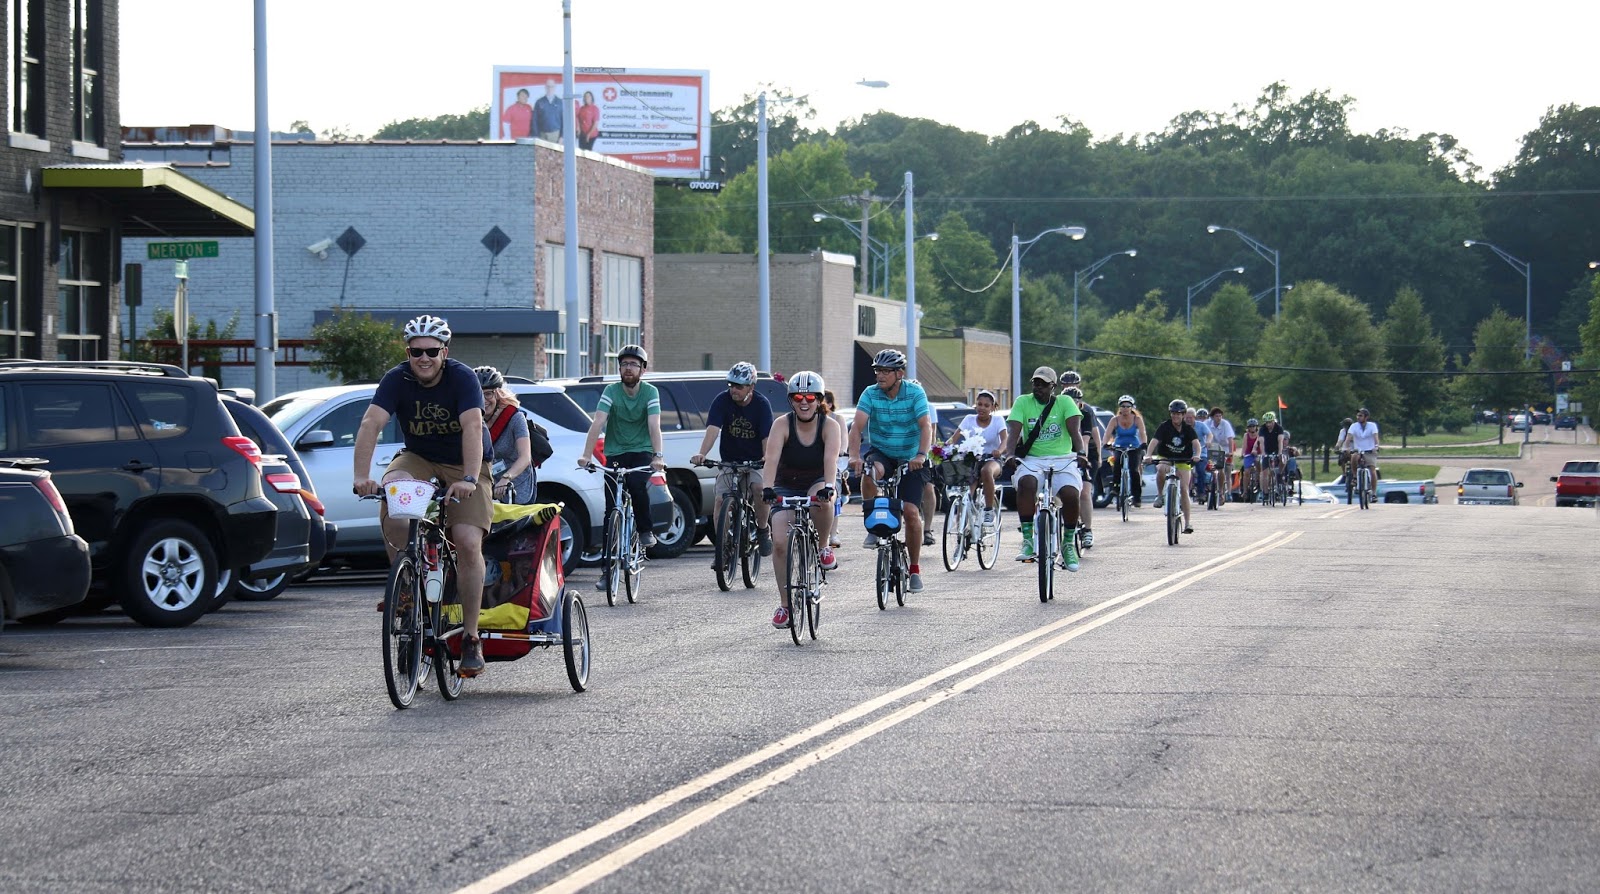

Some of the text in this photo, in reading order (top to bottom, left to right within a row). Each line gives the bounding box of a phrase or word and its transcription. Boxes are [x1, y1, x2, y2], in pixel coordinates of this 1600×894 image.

[639, 90, 673, 98] Community
[689, 181, 719, 190] 070071
[150, 243, 203, 258] MERTON
[414, 400, 422, 419] I
